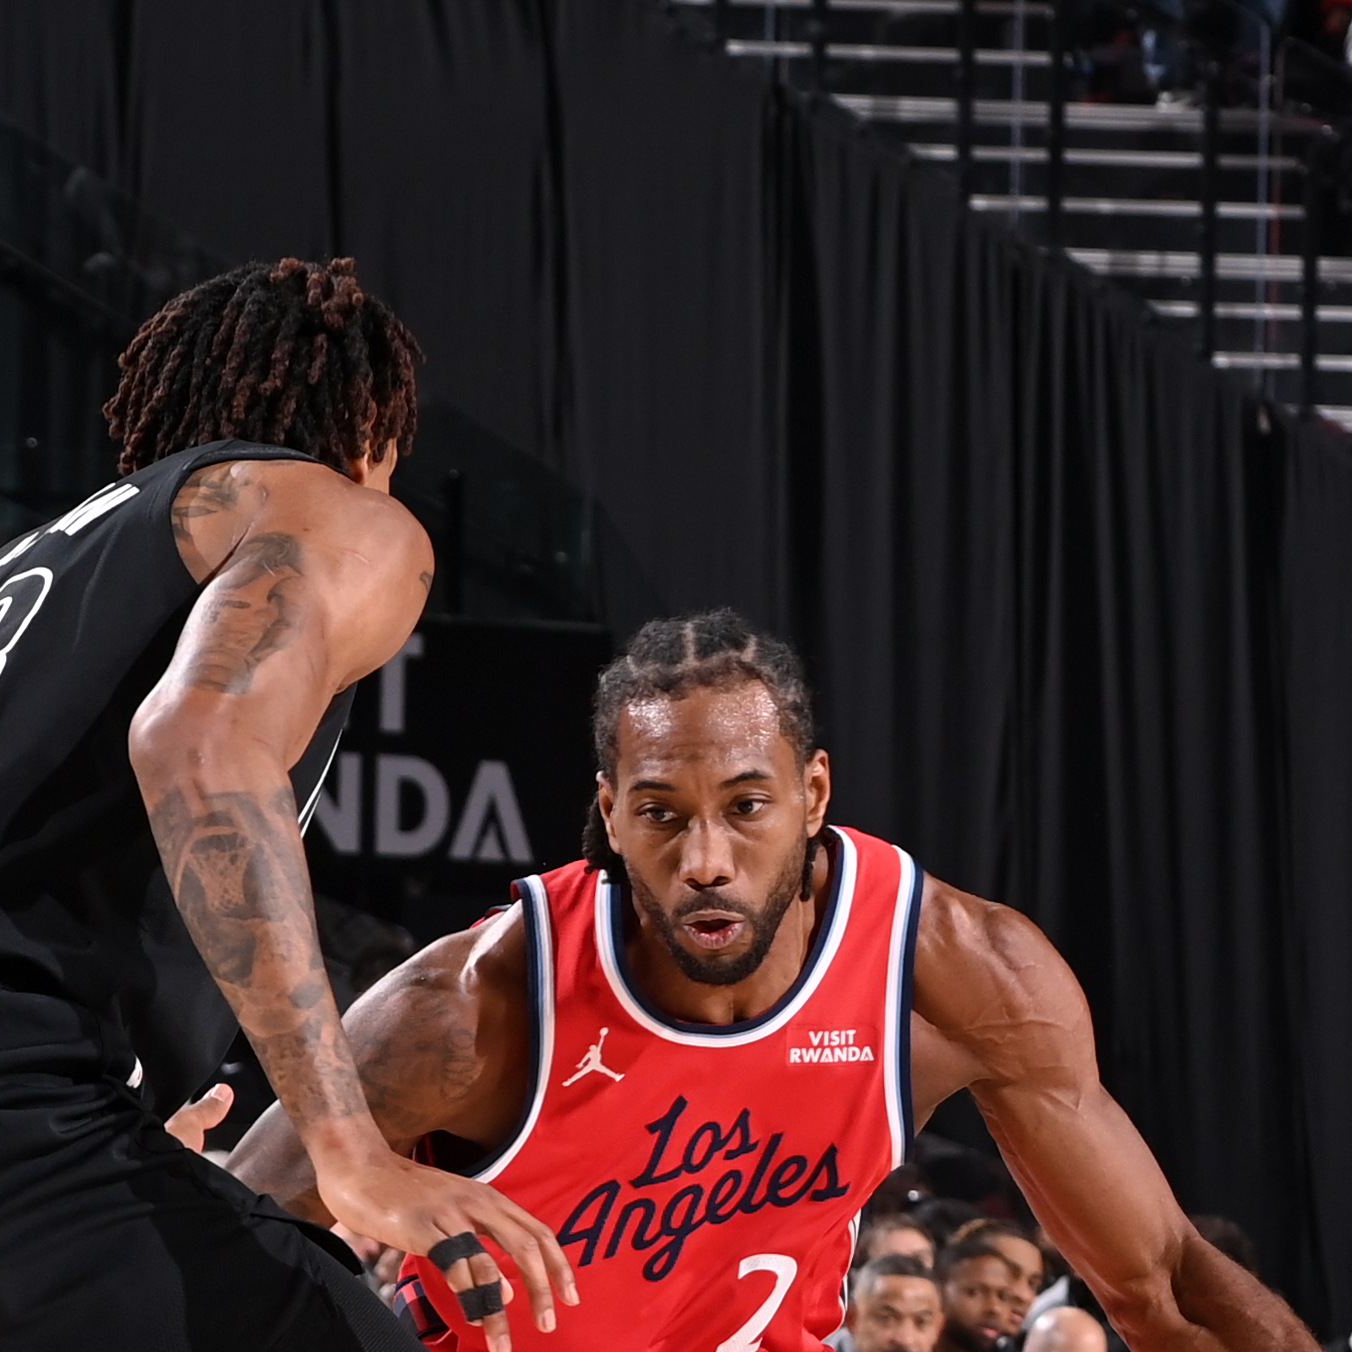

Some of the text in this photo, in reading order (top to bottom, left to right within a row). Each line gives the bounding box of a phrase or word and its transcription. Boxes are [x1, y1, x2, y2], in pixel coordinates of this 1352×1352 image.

[789, 1045, 875, 1064] RWANDA
[808, 1029, 857, 1046] VISIT
[629, 1095, 760, 1189] Los
[556, 1133, 851, 1282] Angeles
